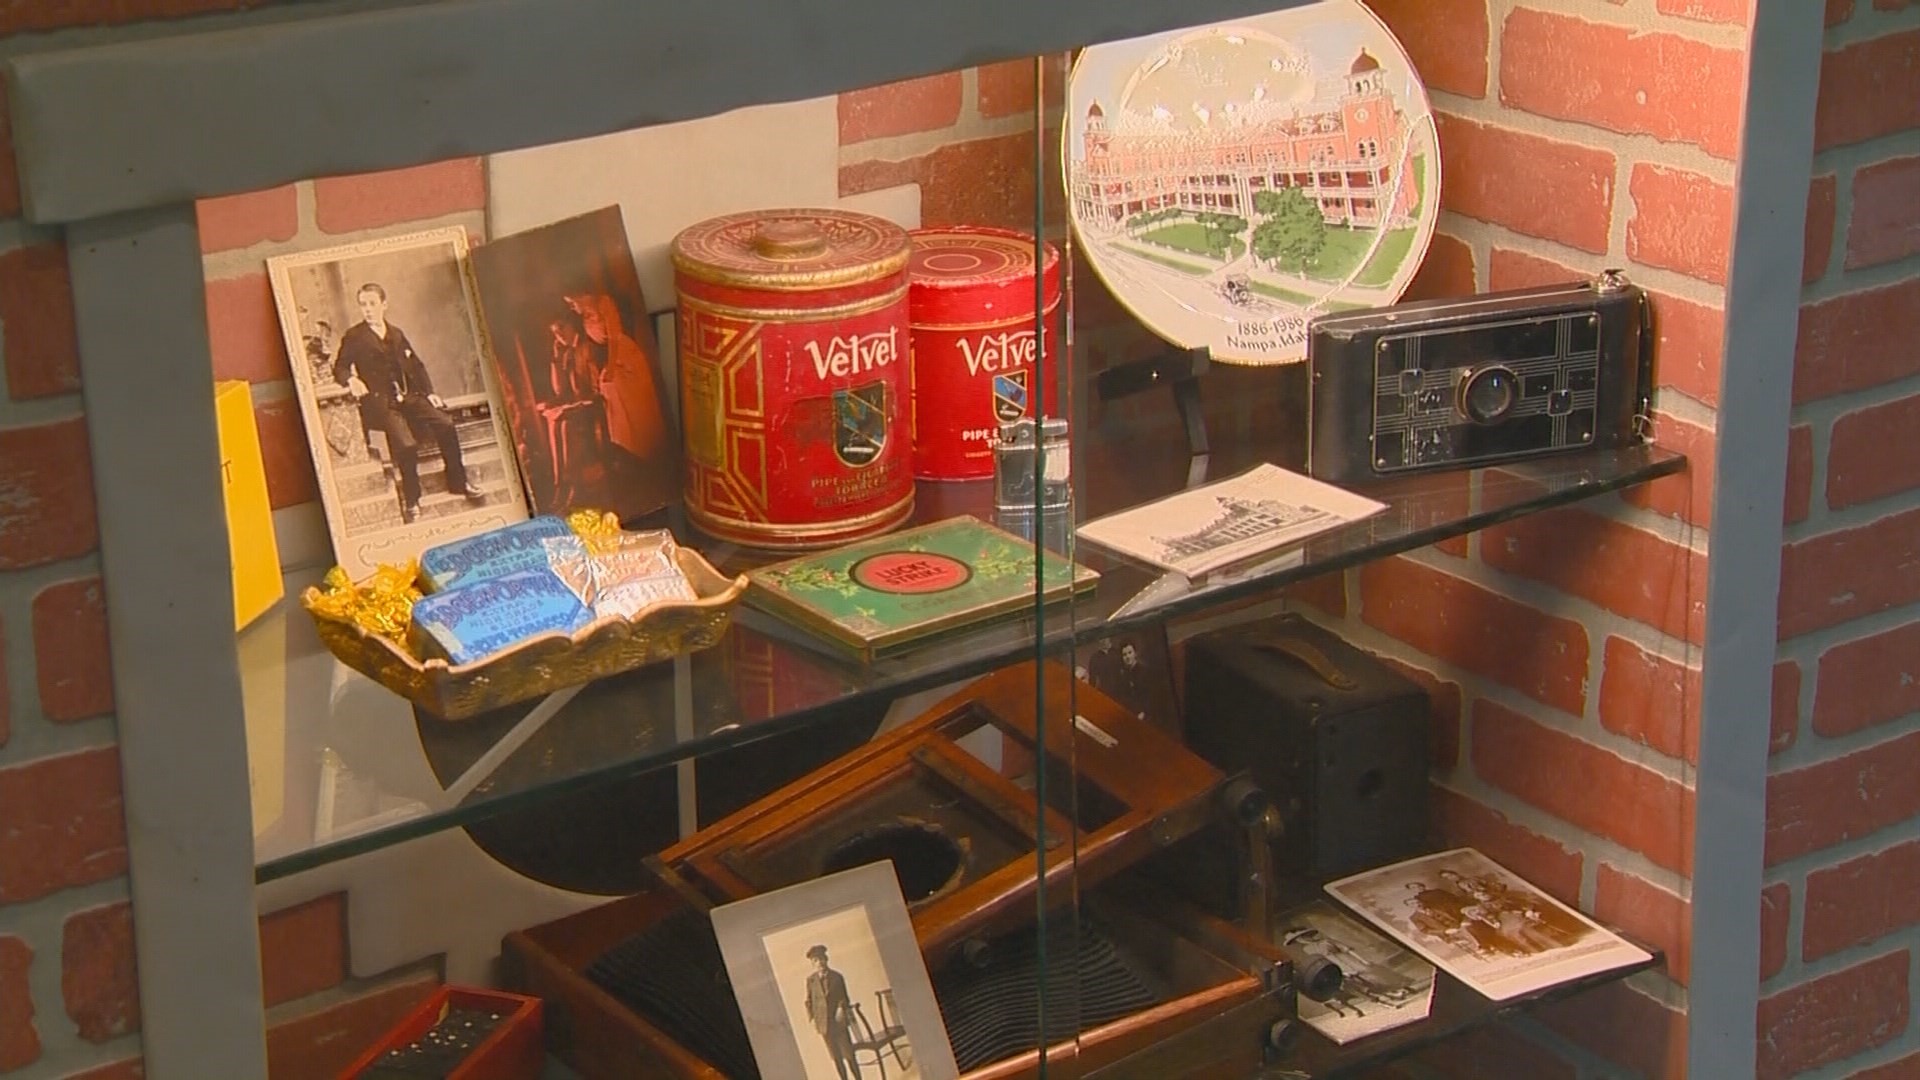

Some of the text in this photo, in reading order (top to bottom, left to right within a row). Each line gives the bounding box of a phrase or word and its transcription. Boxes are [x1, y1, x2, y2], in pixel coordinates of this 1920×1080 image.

[1238, 316, 1304, 335] 1886-1986
[1280, 330, 1308, 347] Ida
[803, 325, 898, 380] Velvet
[956, 324, 1047, 376] Velvet
[963, 429, 991, 440] PIPE
[812, 477, 838, 488] PIPE
[875, 561, 932, 579] LUCKY
[886, 567, 948, 585] STRIKE
